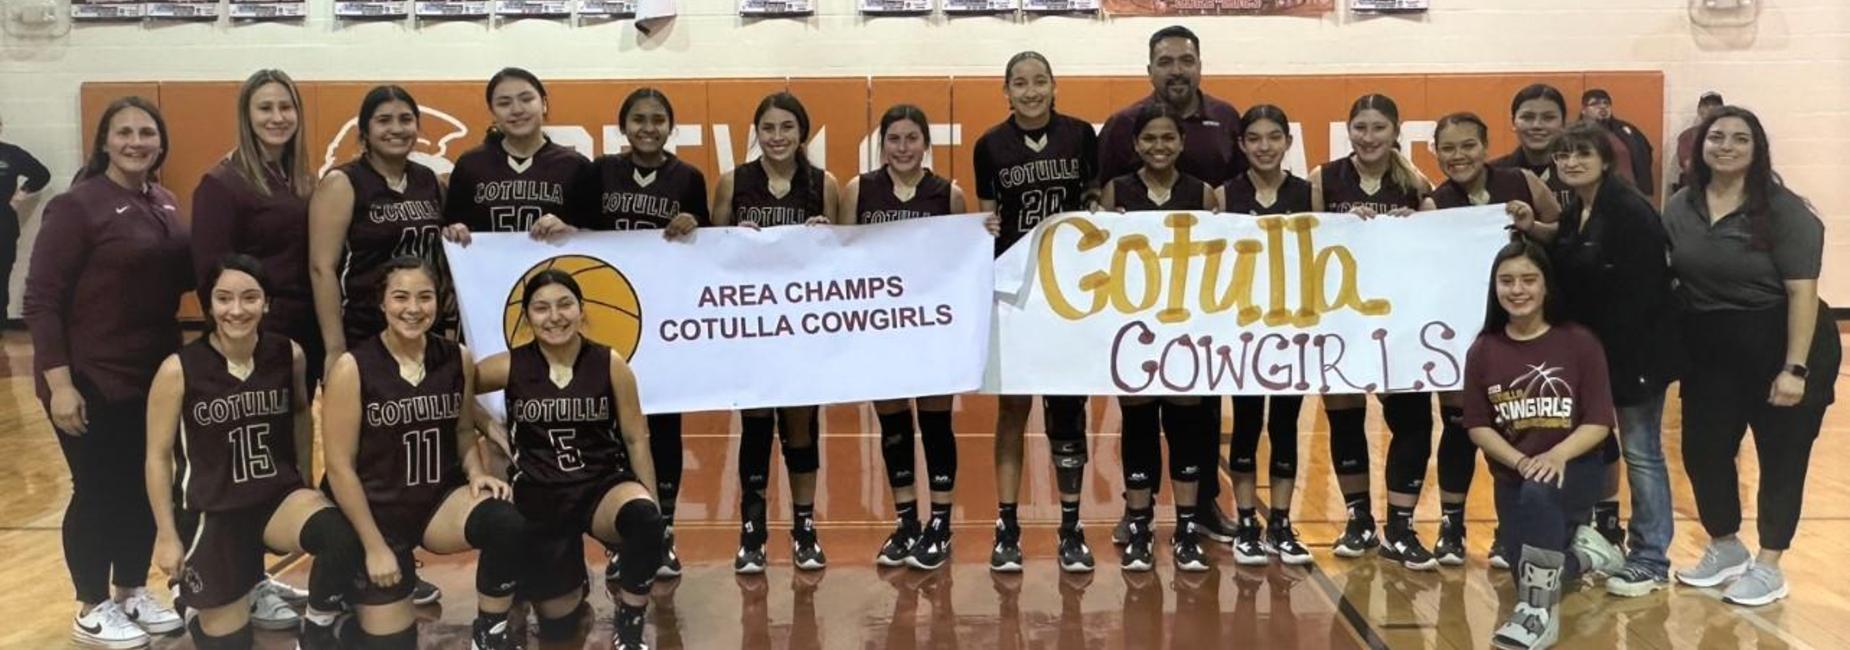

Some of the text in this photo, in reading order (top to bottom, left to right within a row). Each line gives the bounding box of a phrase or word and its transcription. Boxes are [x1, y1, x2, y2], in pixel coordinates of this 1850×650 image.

[1000, 157, 1081, 189] COTULLA
[474, 180, 564, 206] COTULLA
[601, 192, 681, 219] COTULLA
[737, 206, 806, 227] COTULL
[697, 275, 904, 308] AREA CHAMPS
[659, 304, 953, 342] COTULLA COWGIRLS
[1111, 321, 1461, 393] COWGIRLS
[513, 397, 609, 422] COTULLA
[228, 423, 278, 484] 15
[402, 427, 441, 487] 11
[548, 428, 586, 472] 5
